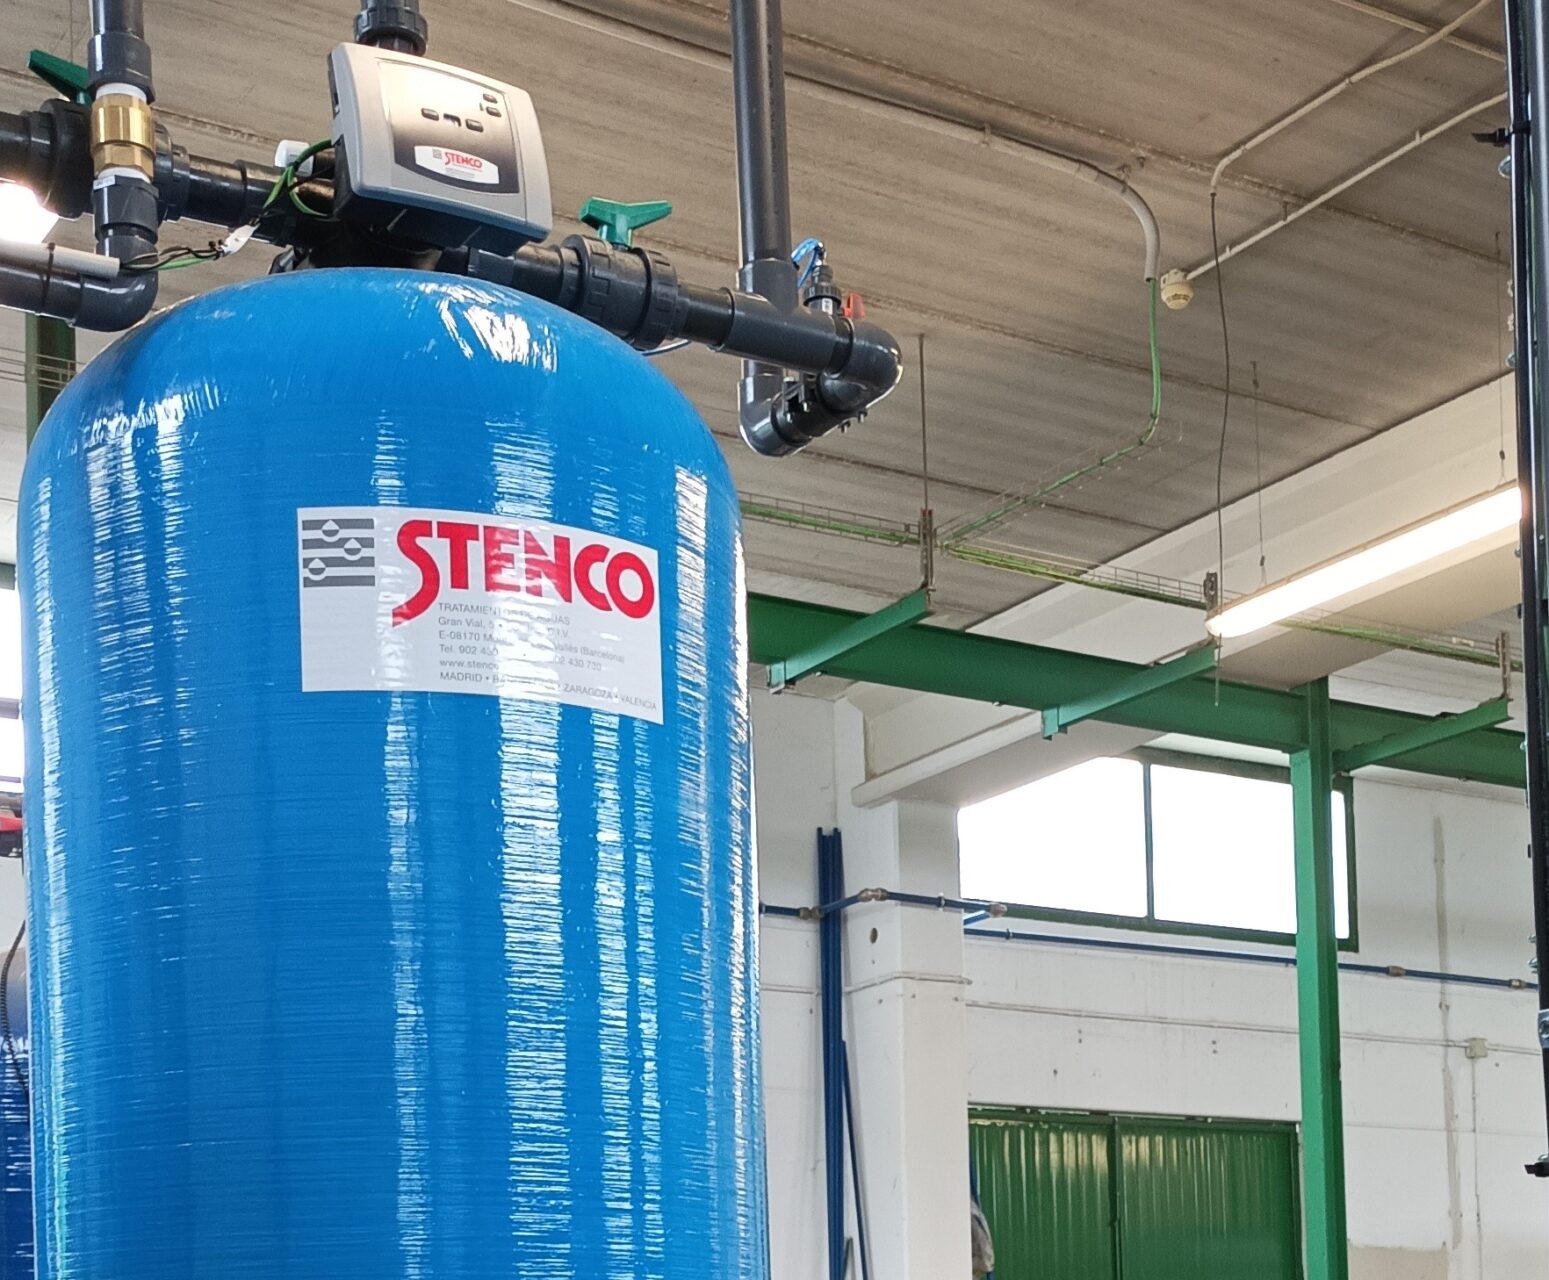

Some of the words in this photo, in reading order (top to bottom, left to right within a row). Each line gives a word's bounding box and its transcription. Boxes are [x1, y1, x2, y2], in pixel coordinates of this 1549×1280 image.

[445, 152, 483, 168] STENCO
[392, 519, 655, 628] STENCO
[439, 617, 462, 626] Gran
[459, 645, 477, 656] 902
[440, 672, 482, 683] MADRID
[564, 683, 613, 699] ZARAGOZA
[621, 695, 658, 710] VALENCIA
